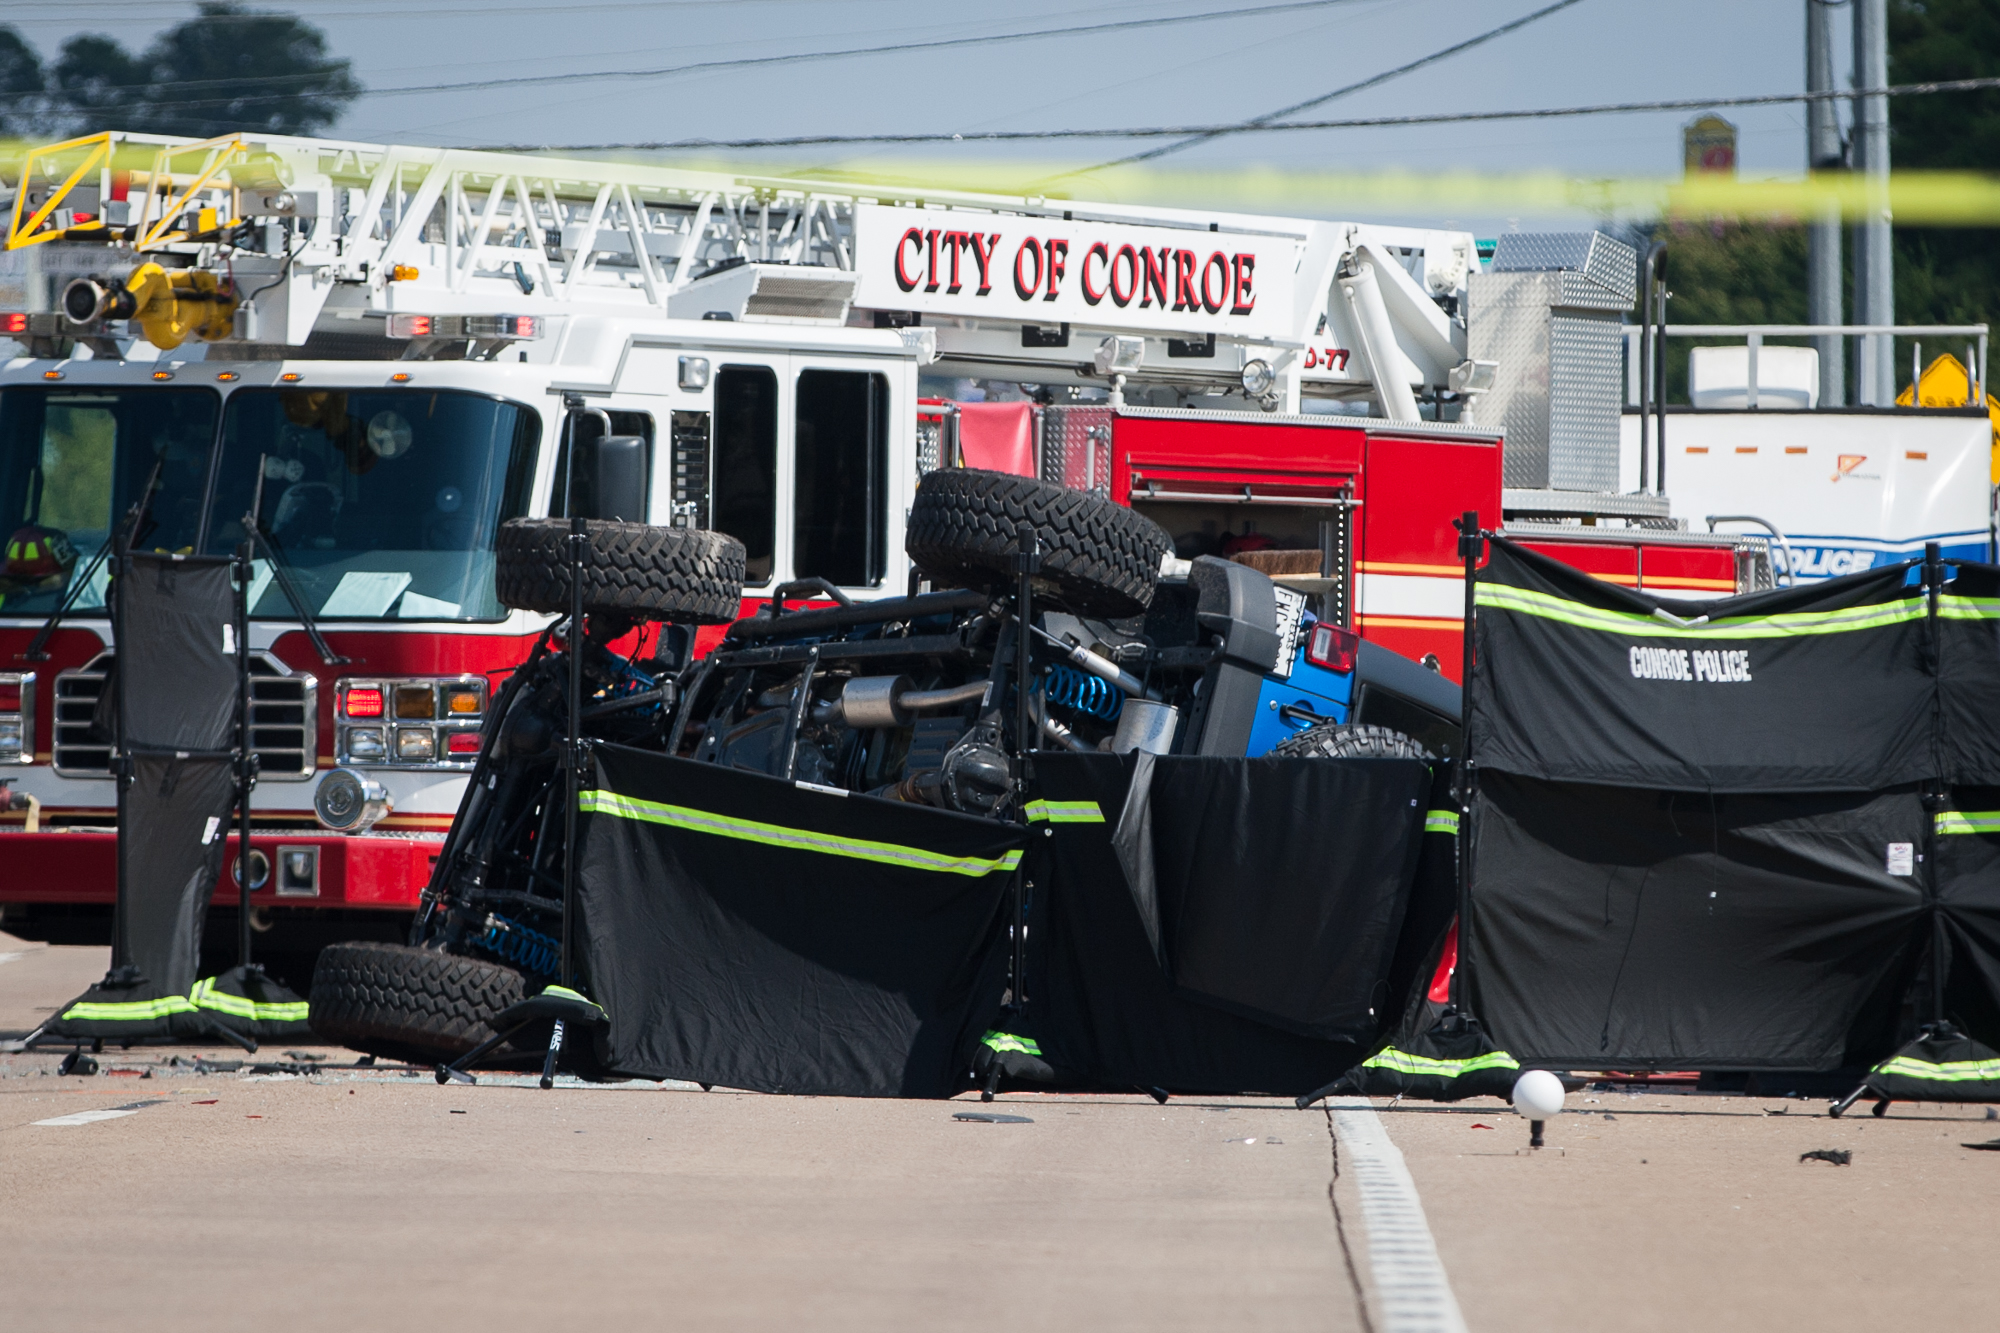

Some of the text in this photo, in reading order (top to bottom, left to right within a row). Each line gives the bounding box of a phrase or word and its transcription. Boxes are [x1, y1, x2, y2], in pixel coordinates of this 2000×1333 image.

[894, 227, 1257, 316] CITY OF CONROE
[1773, 548, 1876, 576] POLICE
[1629, 645, 1753, 682] CONROE POLICE
